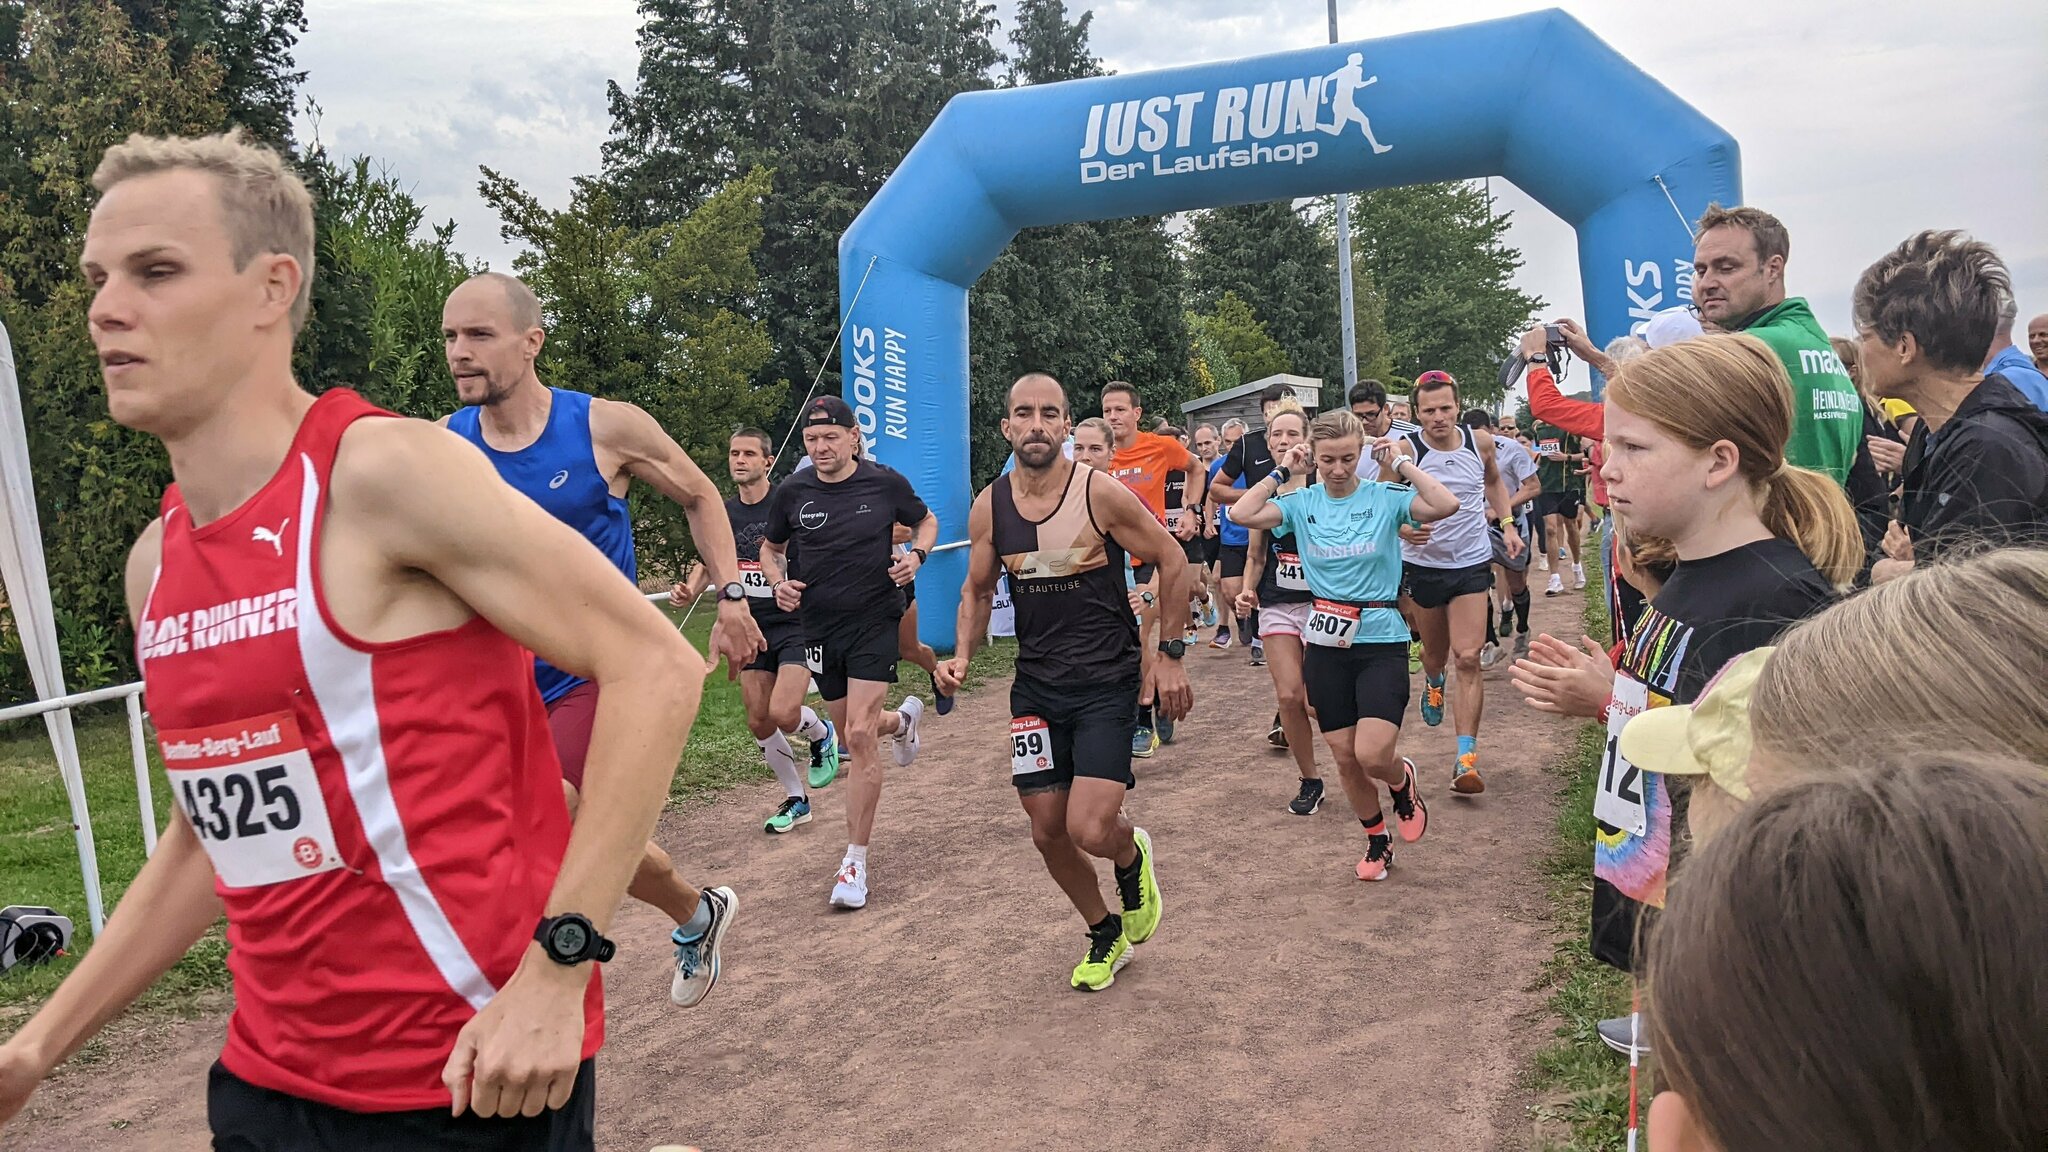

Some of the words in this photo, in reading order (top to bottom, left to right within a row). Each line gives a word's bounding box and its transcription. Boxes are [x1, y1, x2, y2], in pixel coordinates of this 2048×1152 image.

[1080, 91, 1205, 159] JUST
[1212, 75, 1323, 143] RUN
[1080, 160, 1145, 184] Der
[1153, 141, 1319, 176] Laufshop
[884, 327, 907, 392] HAPPY
[853, 324, 877, 461] ROOKS
[885, 398, 908, 439] RUN
[1029, 580, 1081, 593] SAUTEUSE
[1308, 613, 1353, 637] 4607
[182, 764, 302, 841] 4325
